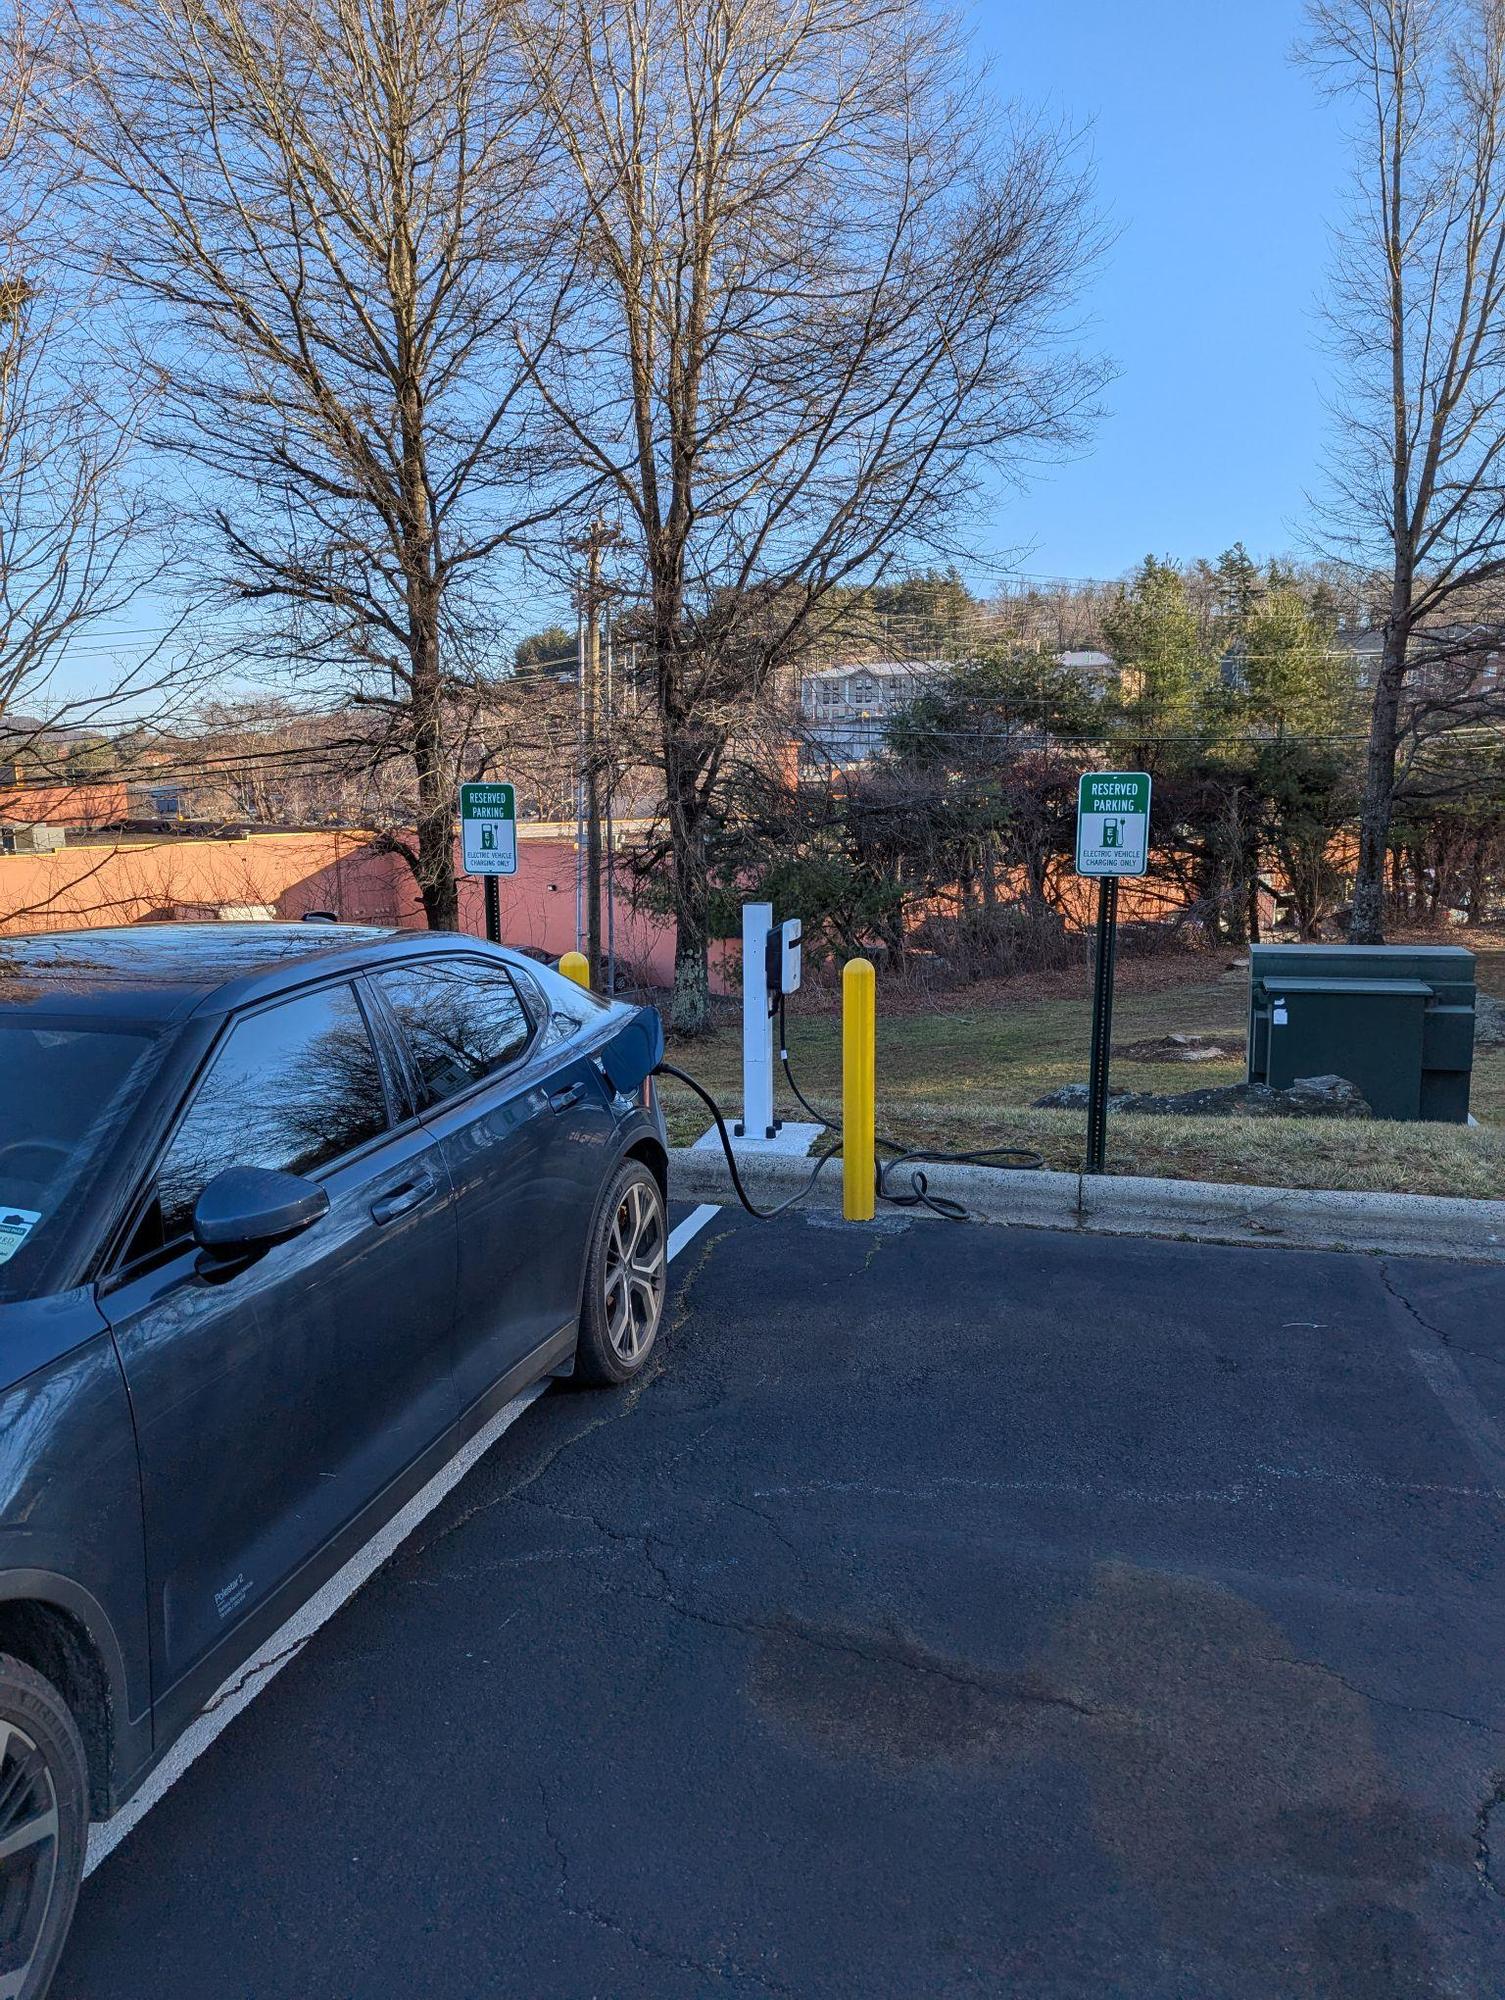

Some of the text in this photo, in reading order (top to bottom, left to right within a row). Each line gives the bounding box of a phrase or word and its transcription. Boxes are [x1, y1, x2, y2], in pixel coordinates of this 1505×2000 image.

[1091, 783, 1138, 796] RESERVED
[469, 792, 506, 804] RESERVED
[1093, 799, 1135, 812] PARKING
[472, 806, 505, 818] PARKING
[467, 851, 512, 860] ELECTRIC VEHICLE
[1083, 850, 1141, 858] ELECTRIC VEHICLE
[497, 860, 510, 868] ONLY
[1086, 859, 1137, 867] CHARGING ONLY
